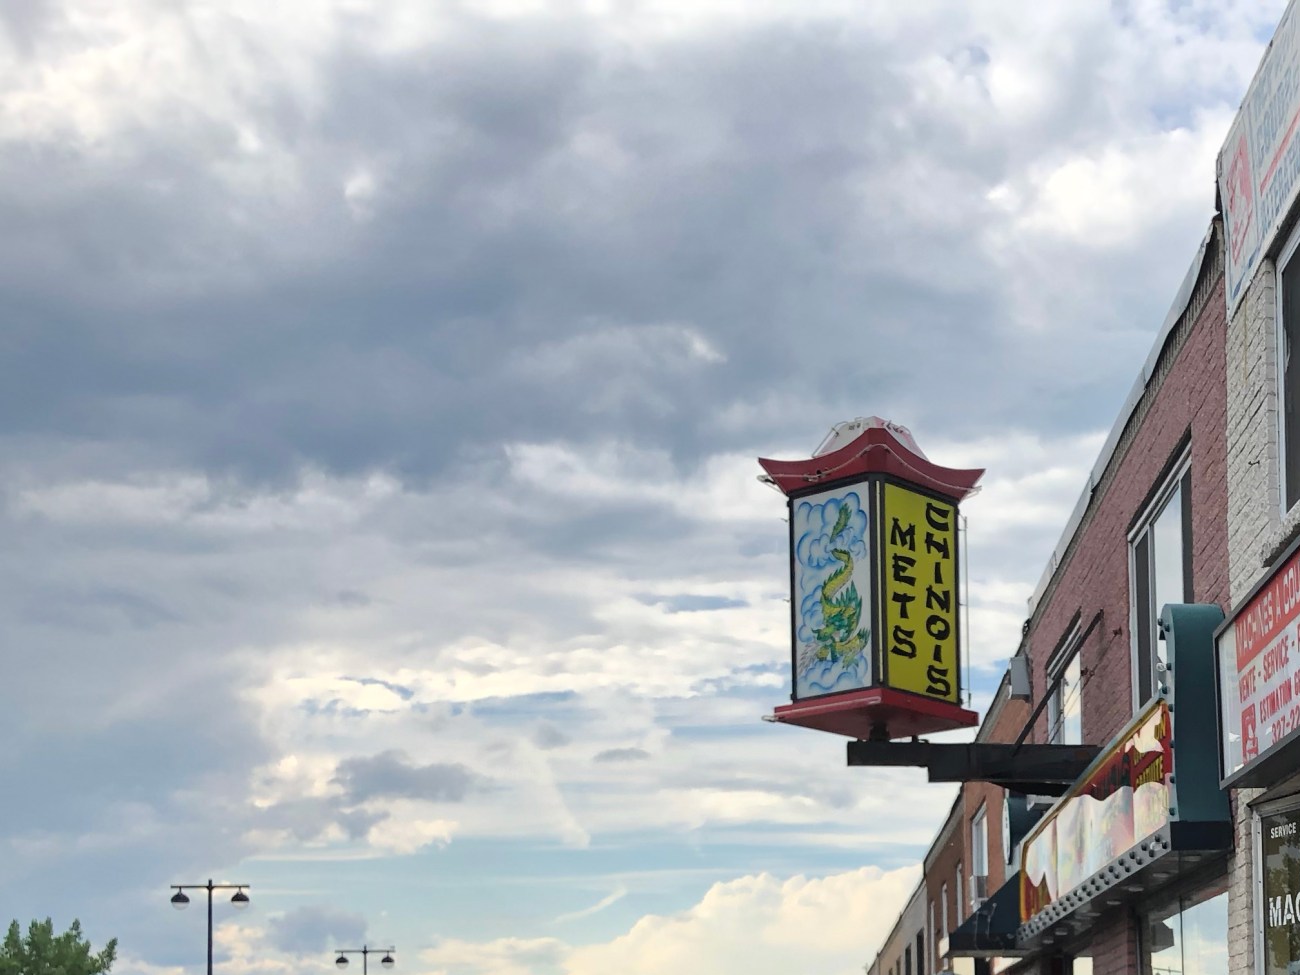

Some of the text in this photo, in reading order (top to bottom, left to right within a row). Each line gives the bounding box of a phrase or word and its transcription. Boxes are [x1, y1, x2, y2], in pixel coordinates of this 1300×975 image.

[890, 517, 917, 659] METS
[924, 502, 951, 697] CHINOIS
[1236, 591, 1274, 657] MACHINES
[1239, 665, 1256, 704] VENTE
[1263, 634, 1289, 683] SERVICE
[1260, 677, 1292, 724] ESTIMATION
[1270, 822, 1296, 839] SERVICE
